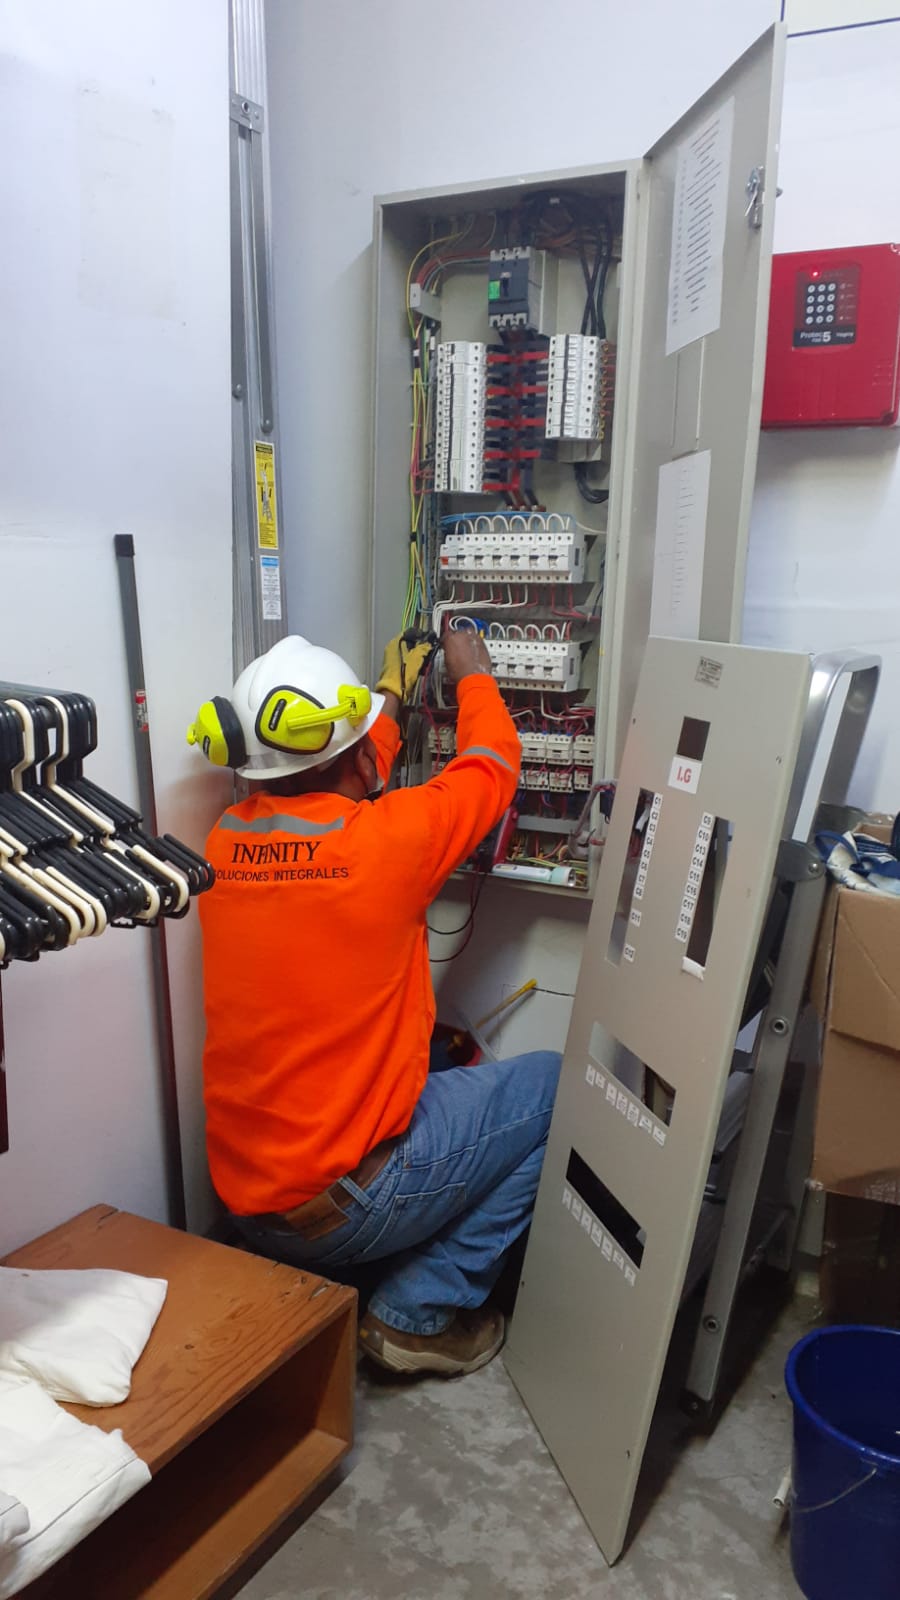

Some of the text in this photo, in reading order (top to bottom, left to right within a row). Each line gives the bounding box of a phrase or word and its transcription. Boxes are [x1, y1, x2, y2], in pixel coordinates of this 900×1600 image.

[823, 331, 831, 342] 5
[214, 866, 349, 882] OLUCIONES INTEGRALES
